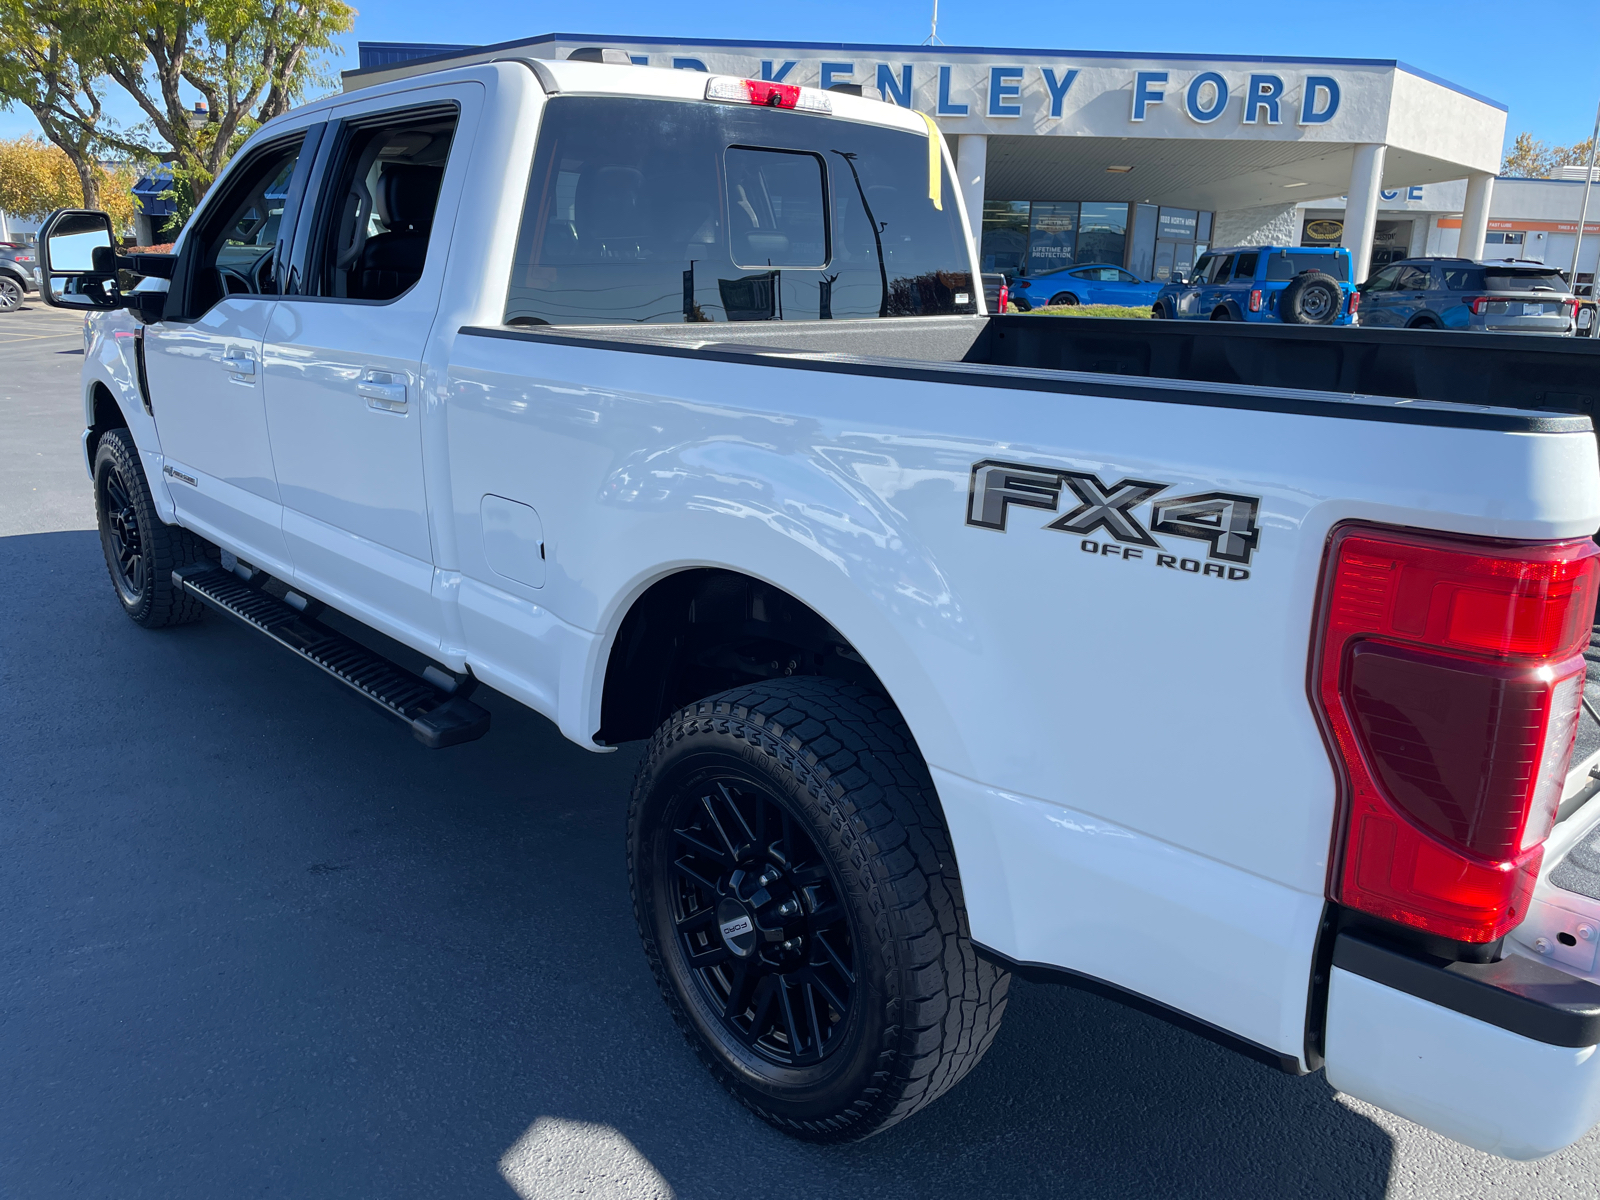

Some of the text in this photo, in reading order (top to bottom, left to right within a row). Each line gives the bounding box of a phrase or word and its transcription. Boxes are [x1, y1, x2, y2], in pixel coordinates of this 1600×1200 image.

[1130, 69, 1342, 126] FORD
[964, 457, 1263, 567] FX4
[1080, 538, 1251, 582] OFF ROAD
[741, 744, 800, 797] OPEN
[723, 921, 748, 935] FORD
